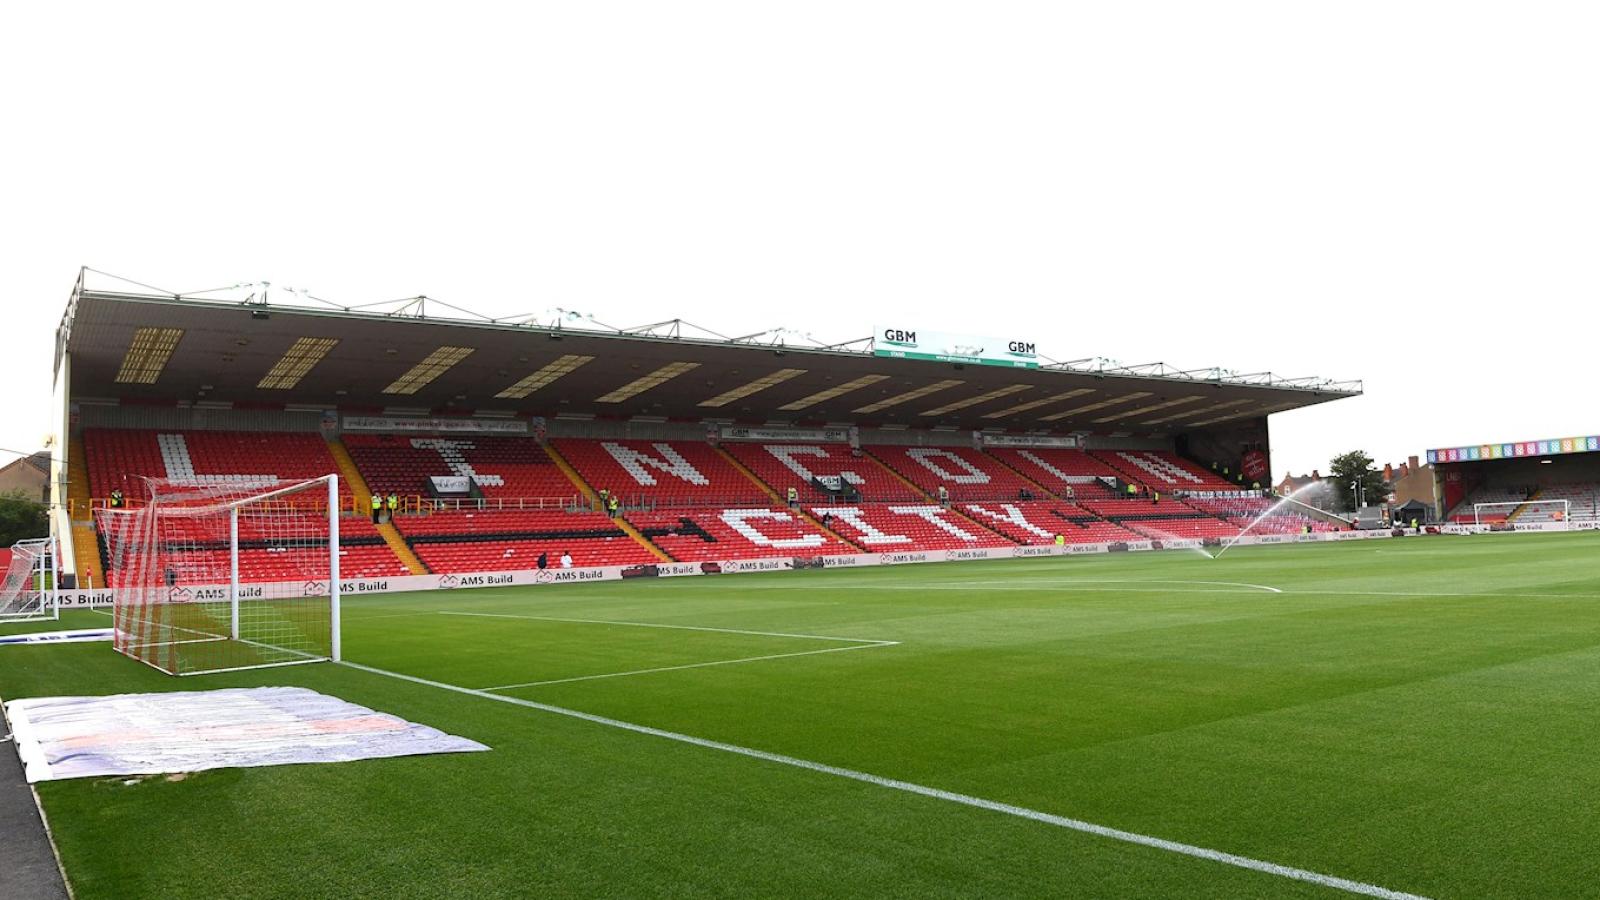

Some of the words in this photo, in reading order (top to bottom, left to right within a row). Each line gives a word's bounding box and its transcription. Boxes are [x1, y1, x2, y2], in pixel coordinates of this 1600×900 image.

[885, 329, 916, 343] GBM
[1008, 341, 1036, 353] GBM
[718, 505, 1054, 548] CITY
[673, 566, 694, 574] Build
[739, 562, 757, 570] AMS
[759, 561, 779, 569] Build
[460, 576, 484, 586] AMS
[488, 574, 513, 584] Build
[555, 572, 577, 581] AMS
[579, 570, 603, 580] Build
[358, 581, 387, 591] Build
[195, 590, 225, 600] AMS
[238, 587, 262, 597] uild
